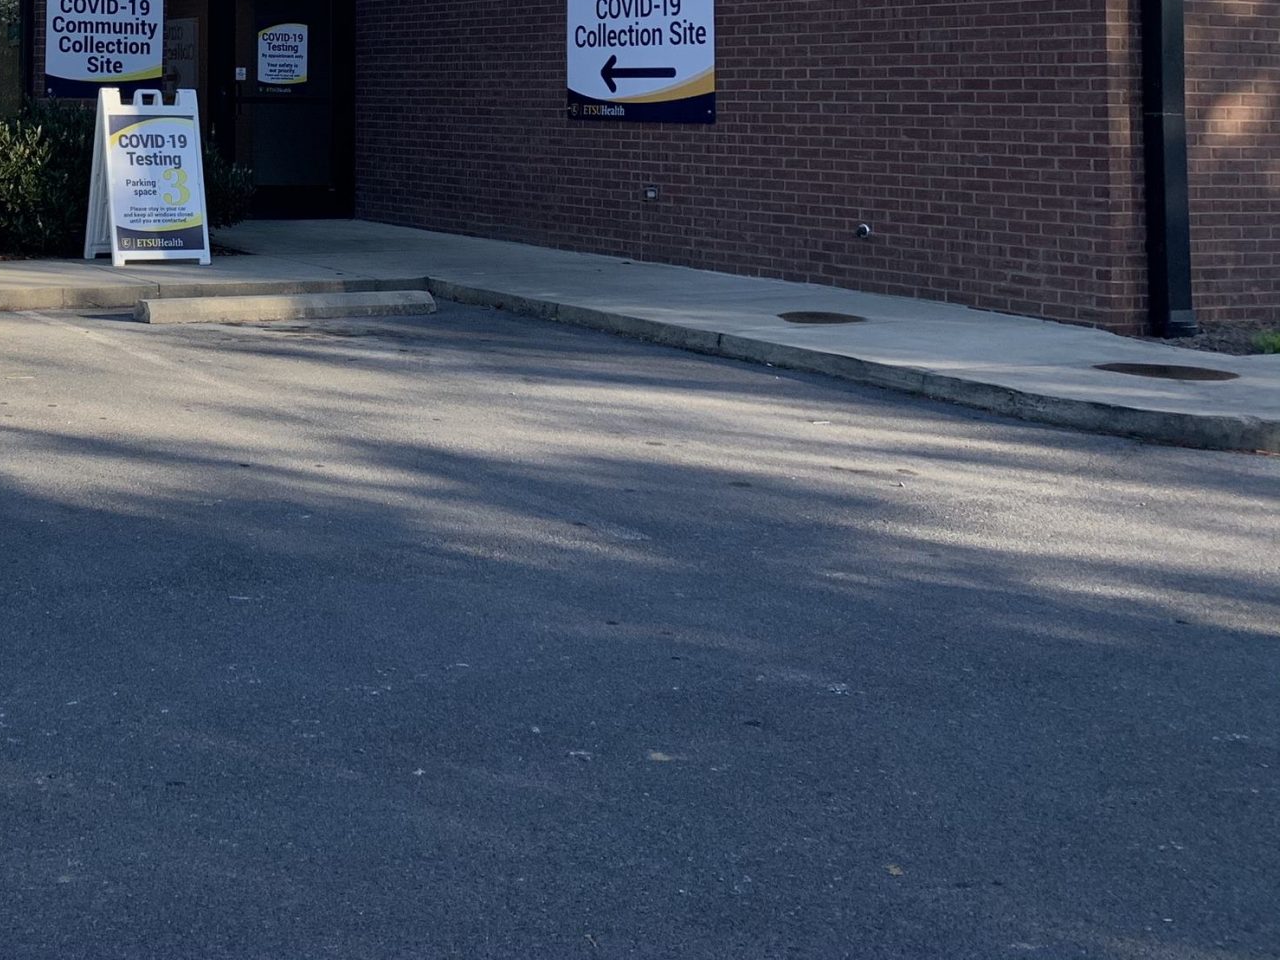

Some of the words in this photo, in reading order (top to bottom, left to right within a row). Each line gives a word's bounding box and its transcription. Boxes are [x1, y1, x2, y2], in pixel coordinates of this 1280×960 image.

[53, 15, 157, 40] Community
[575, 22, 662, 47] Collection
[670, 19, 706, 45] Site
[262, 33, 303, 42] COVID-19
[59, 36, 151, 55] Collection
[267, 42, 298, 54] Testing
[87, 56, 123, 73] Site
[583, 105, 625, 116] ETSUHealth
[118, 134, 187, 148] COVID-19
[126, 151, 181, 169] Testing
[126, 179, 156, 188] Parking
[162, 169, 190, 205] 3
[134, 188, 157, 197] space
[137, 238, 183, 247] ETSUHealth
